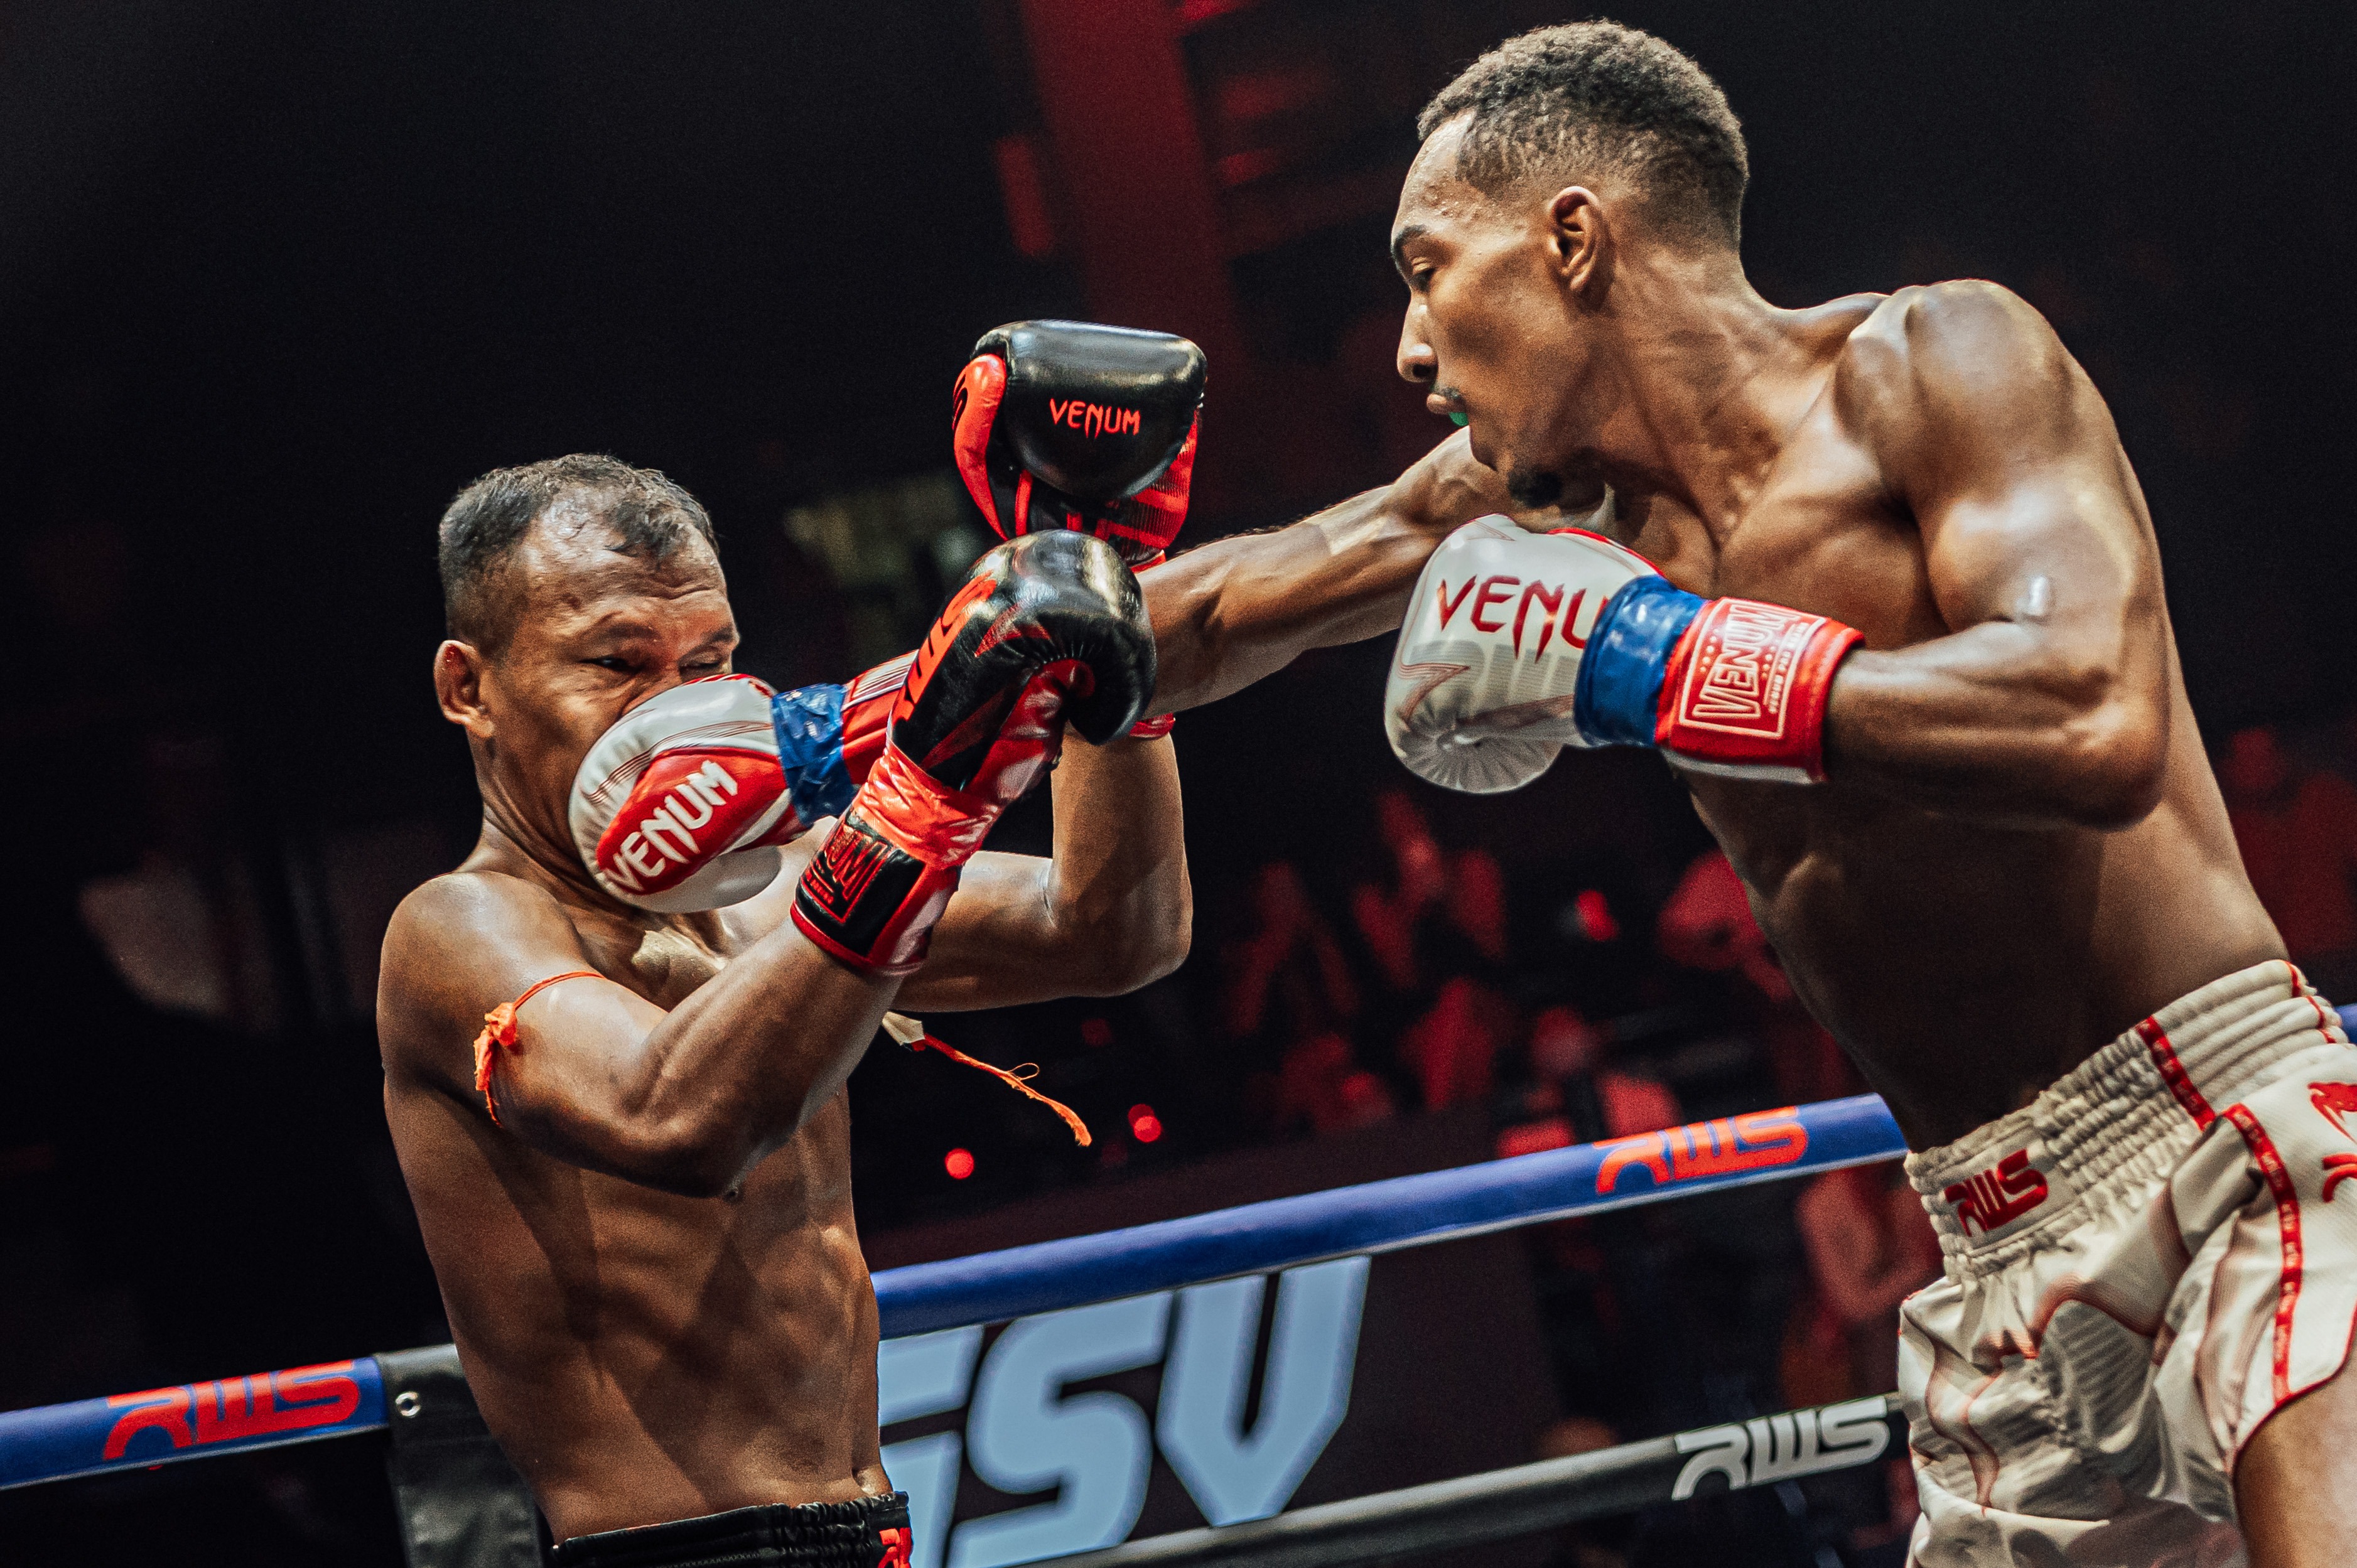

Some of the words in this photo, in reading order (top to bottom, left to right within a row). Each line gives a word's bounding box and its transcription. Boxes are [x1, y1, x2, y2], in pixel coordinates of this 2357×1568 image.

[1049, 398, 1141, 439] VENUM
[1437, 574, 1610, 663] VENU
[1692, 604, 1801, 719] VENUM
[601, 760, 738, 891] VENUM
[1594, 1105, 1808, 1195] RWS
[1944, 1147, 2049, 1237] RWS
[102, 1359, 360, 1461] RWS
[1671, 1395, 1890, 1501] RWS
